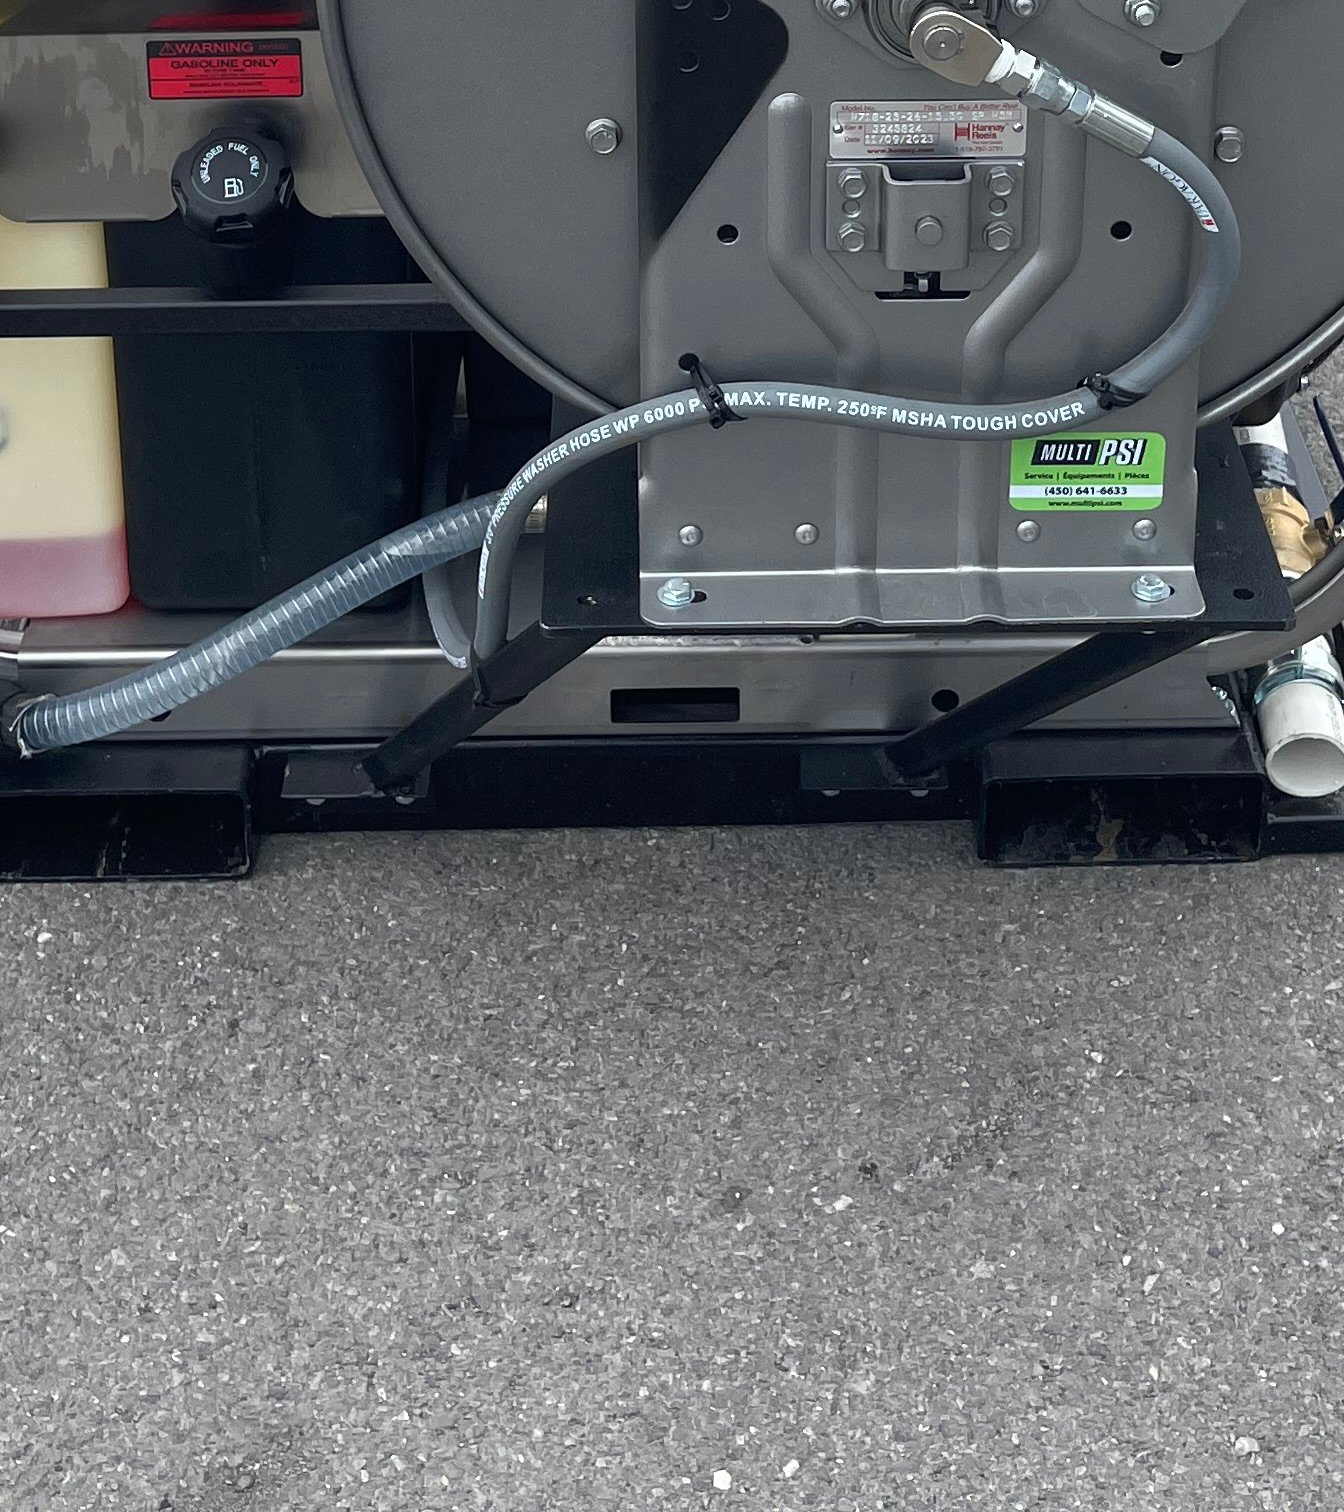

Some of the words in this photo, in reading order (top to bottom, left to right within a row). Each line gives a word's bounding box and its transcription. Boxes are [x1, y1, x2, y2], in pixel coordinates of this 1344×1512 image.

[175, 42, 254, 54] WARNING
[170, 59, 239, 69] GASOLINE
[242, 58, 280, 68] ONLY
[199, 144, 224, 184] UNLEADED
[228, 142, 249, 155] FUEL
[249, 155, 260, 178] ONLY
[724, 391, 771, 406] MAX.
[775, 392, 832, 412] TEMP.
[891, 407, 947, 429] MSHA
[950, 415, 1017, 431] TOUGH
[1021, 401, 1086, 428] COVER
[1040, 443, 1093, 461] MULTI
[1099, 439, 1147, 465] PSI
[491, 476, 525, 528] PRESSURE
[521, 443, 570, 484] WASHER
[569, 424, 612, 452] HOSE
[612, 414, 640, 434] WP
[643, 402, 685, 424] 6000
[1024, 472, 1054, 480] Service
[1044, 486, 1073, 496] (450)
[1075, 486, 1128, 496] 641-6633
